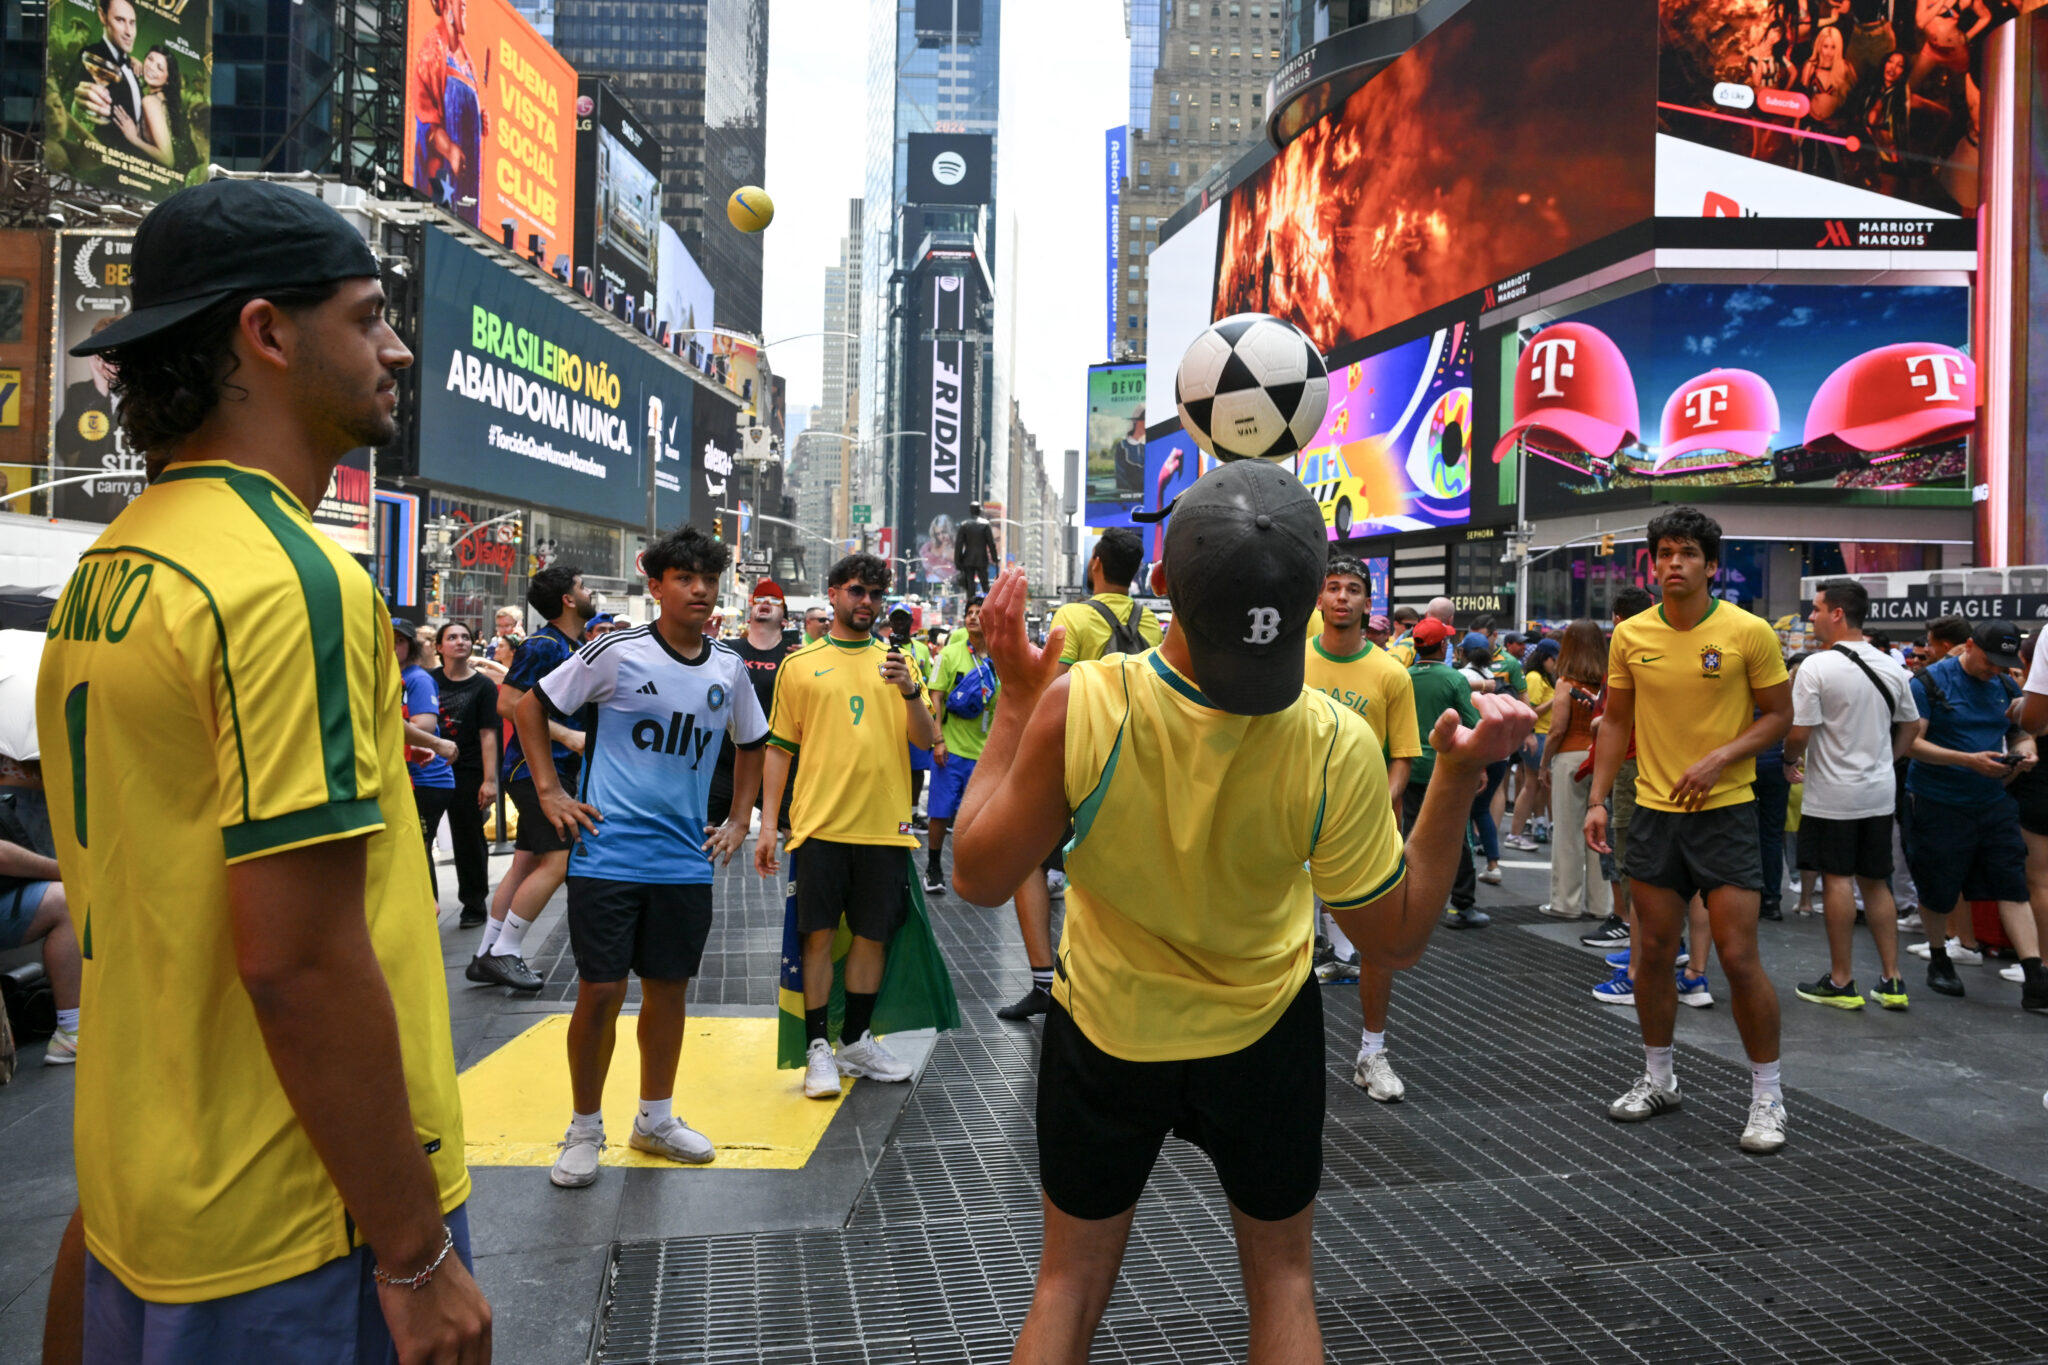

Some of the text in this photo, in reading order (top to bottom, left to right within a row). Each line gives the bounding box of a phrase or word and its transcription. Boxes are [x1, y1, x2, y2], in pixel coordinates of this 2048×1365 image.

[155, 7, 181, 24] MUSICAL
[500, 37, 559, 116] BUENA
[499, 74, 558, 154] VISTA
[576, 119, 592, 131] LG
[107, 147, 152, 170] BROADWAY
[151, 162, 185, 182] THEATRE
[498, 117, 557, 188] SOCIAL
[128, 163, 171, 185] BROADWAY
[497, 157, 557, 226] CLUB
[1859, 221, 1934, 233] MARRIOTT
[1859, 235, 1925, 246] MARQUIS
[105, 241, 113, 255] 8
[1498, 272, 1530, 292] MARRIOTT
[1498, 285, 1526, 303] MARQUIS
[472, 304, 621, 409] BRASILEIRO NÃO
[446, 349, 632, 455] ABANDONA NUNCA.
[934, 357, 959, 491] FRIDAY
[704, 439, 733, 476] alexa+
[97, 481, 142, 496] carry a
[1467, 529, 1494, 540] SEPHORA
[1940, 600, 2002, 618] EAGLE
[1243, 606, 1281, 644] B
[850, 696, 864, 726] 9
[632, 711, 713, 771] ally
